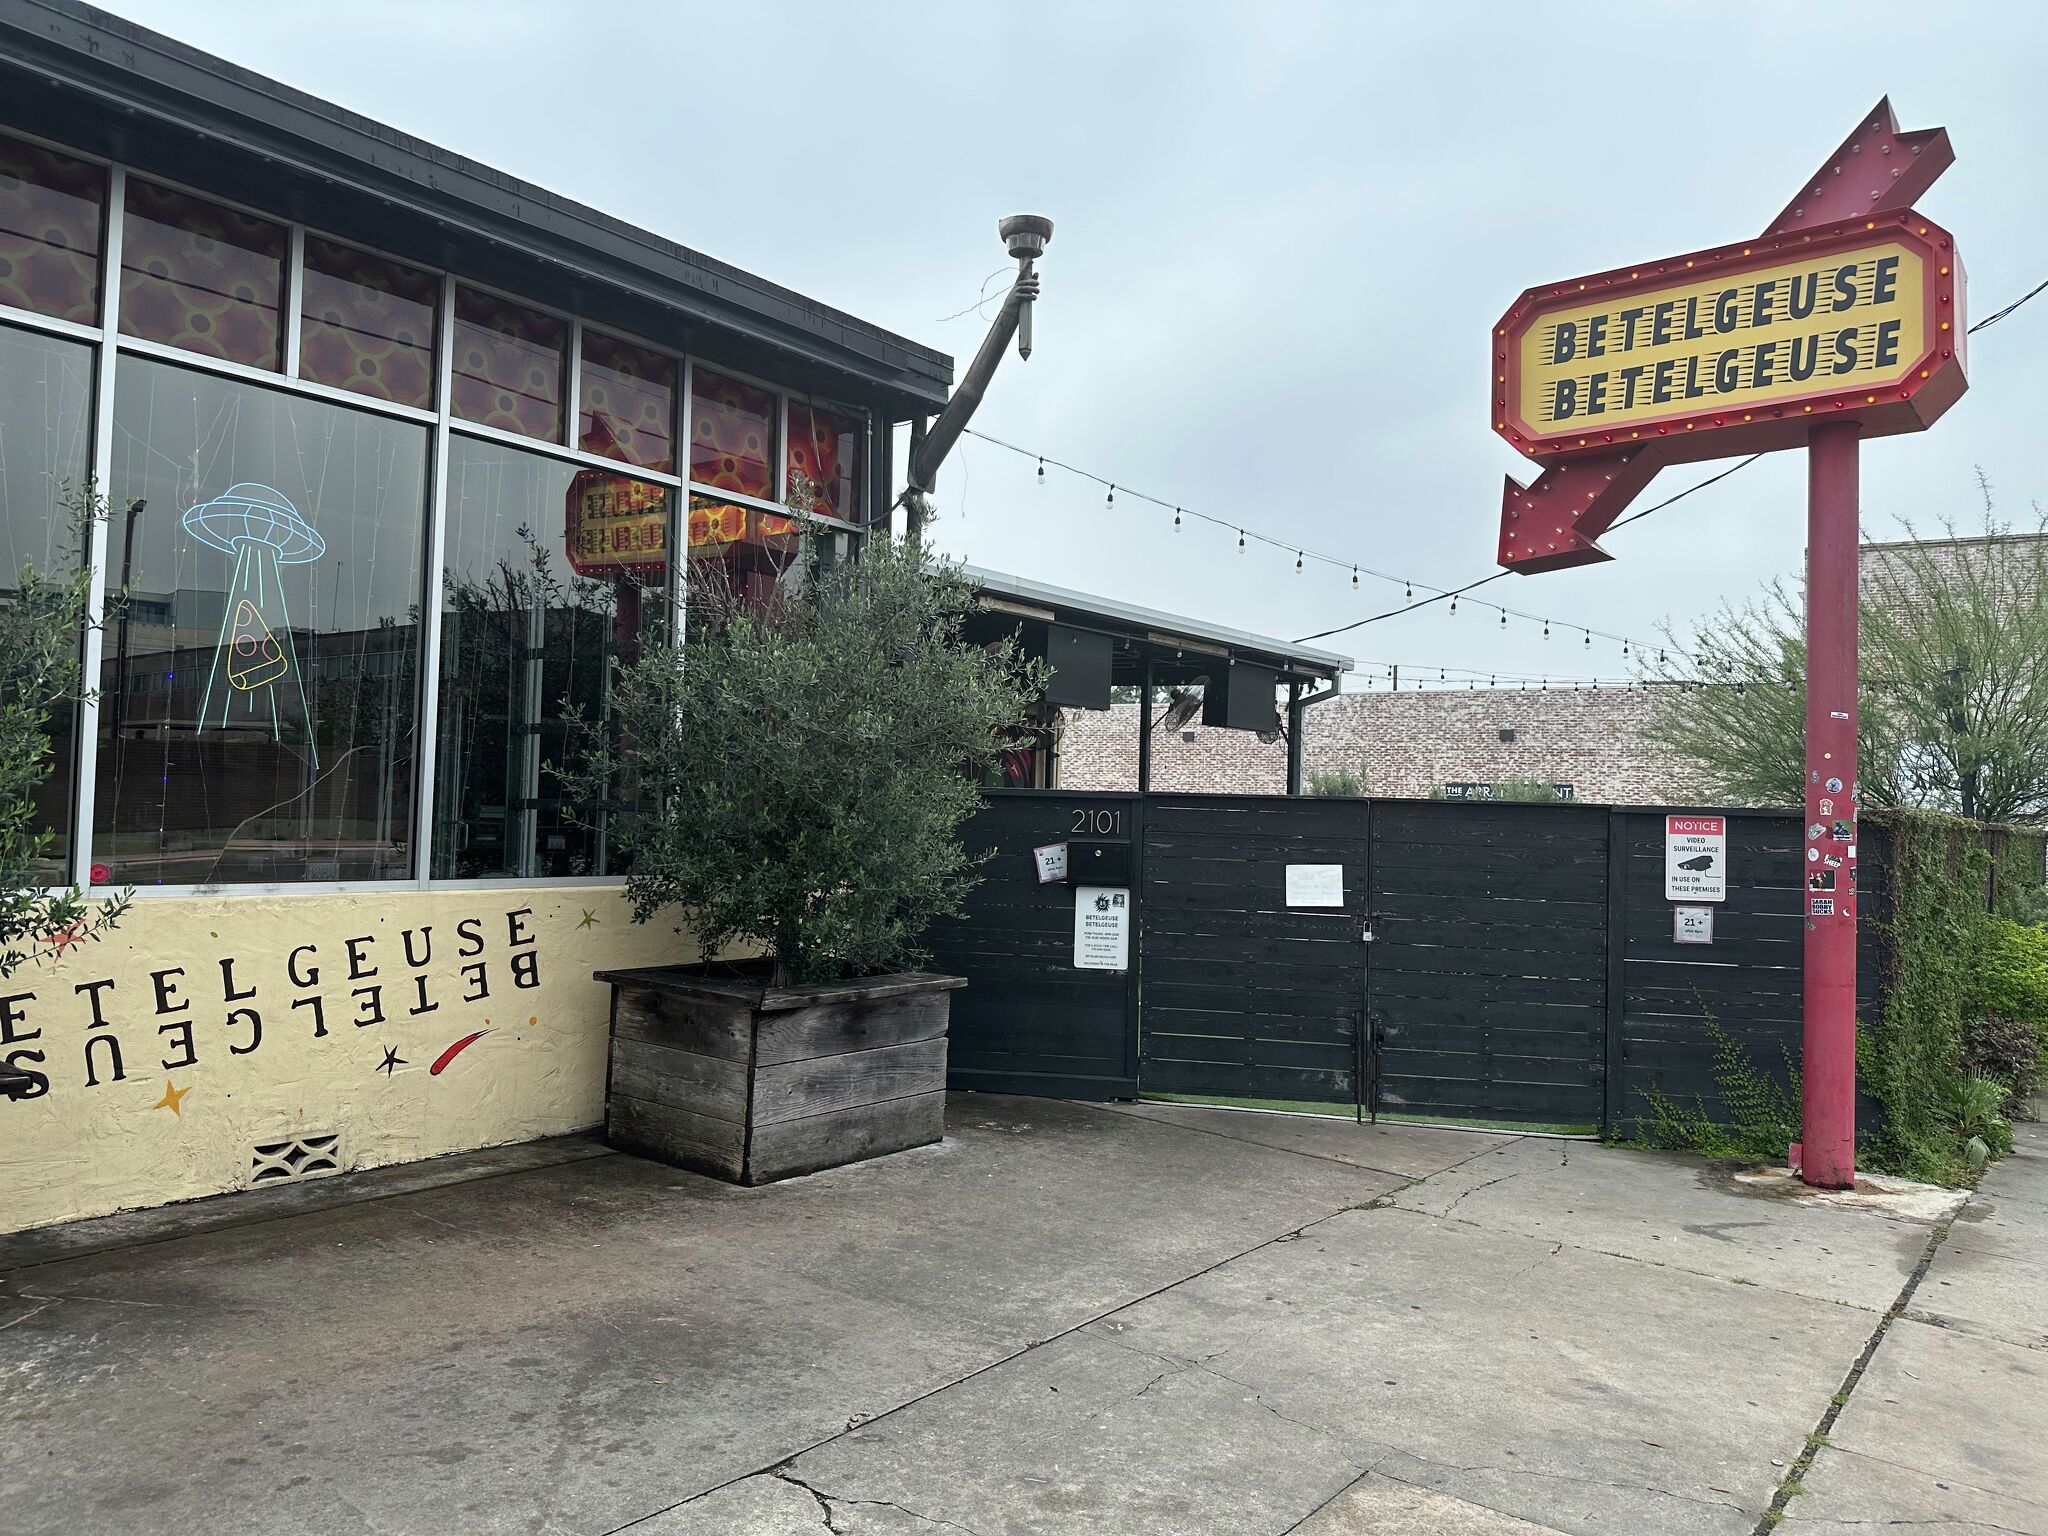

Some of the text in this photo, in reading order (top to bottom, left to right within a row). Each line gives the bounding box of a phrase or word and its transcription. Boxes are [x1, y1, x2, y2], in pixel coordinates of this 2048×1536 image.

[1538, 256, 1900, 365] BETELGEUSE
[1538, 320, 1901, 421] BETELGEUSE
[1071, 809, 1120, 834] 2101
[1674, 821, 1718, 831] NOTICE
[1673, 845, 1719, 853] SURVEILLANCE
